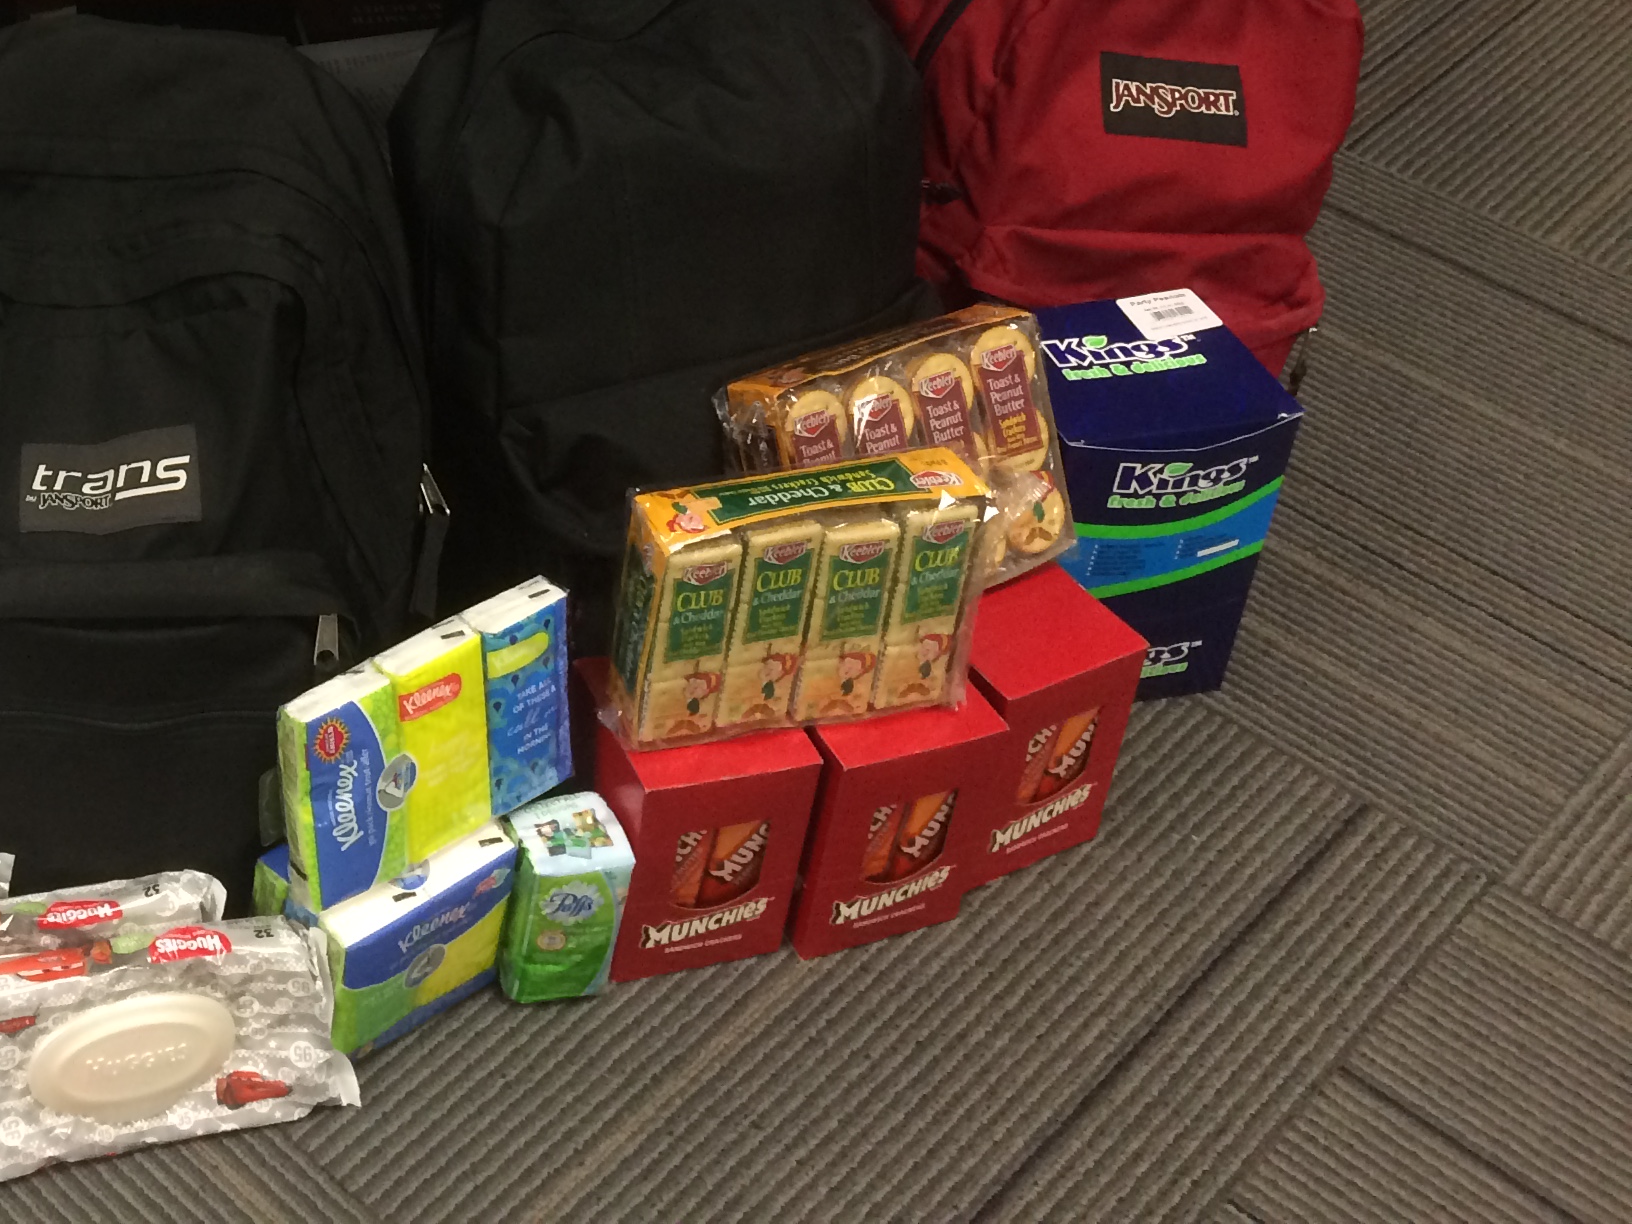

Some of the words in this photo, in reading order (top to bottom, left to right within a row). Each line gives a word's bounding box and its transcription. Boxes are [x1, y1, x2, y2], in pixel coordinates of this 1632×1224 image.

[1109, 78, 1237, 118] JANSPORT
[980, 347, 1017, 369] Keebler
[1040, 335, 1189, 368] Kings
[919, 373, 954, 397] Keebler
[987, 374, 1014, 391] Toast
[1014, 373, 1021, 384] &
[989, 384, 1024, 404] Peanut
[926, 400, 954, 418] Toast
[952, 399, 960, 411] &
[993, 397, 1026, 417] Butter
[794, 411, 829, 435] Keebler
[863, 423, 891, 440] Toast
[890, 422, 898, 433] &
[929, 411, 964, 431] Peanut
[865, 434, 901, 454] Peanut
[932, 425, 965, 445] Butter
[799, 439, 826, 457] Toast
[826, 438, 835, 450] &
[31, 455, 191, 502] trans
[820, 468, 877, 484] Sandwich
[846, 477, 895, 493] CLUB
[911, 472, 963, 487] Keebler
[1112, 457, 1248, 495] Kings
[748, 486, 830, 507] Cheddar
[829, 484, 843, 493] &
[38, 492, 112, 511] JANSPORT
[1107, 494, 1157, 509] fresh
[1158, 494, 1177, 507] &
[923, 520, 965, 542] Keebler
[840, 541, 885, 562] Keebler
[914, 546, 961, 572] CLUB
[756, 568, 803, 593] CLUB
[833, 567, 880, 591] CLUB
[676, 589, 724, 613] CLUB
[760, 589, 804, 605] Cheddar
[403, 682, 454, 715] Kleenex
[332, 759, 364, 852] Kleenex
[143, 883, 161, 898] 32
[253, 927, 275, 939] 32
[397, 900, 471, 954] Kleenex
[154, 934, 222, 954] HUGGIES
